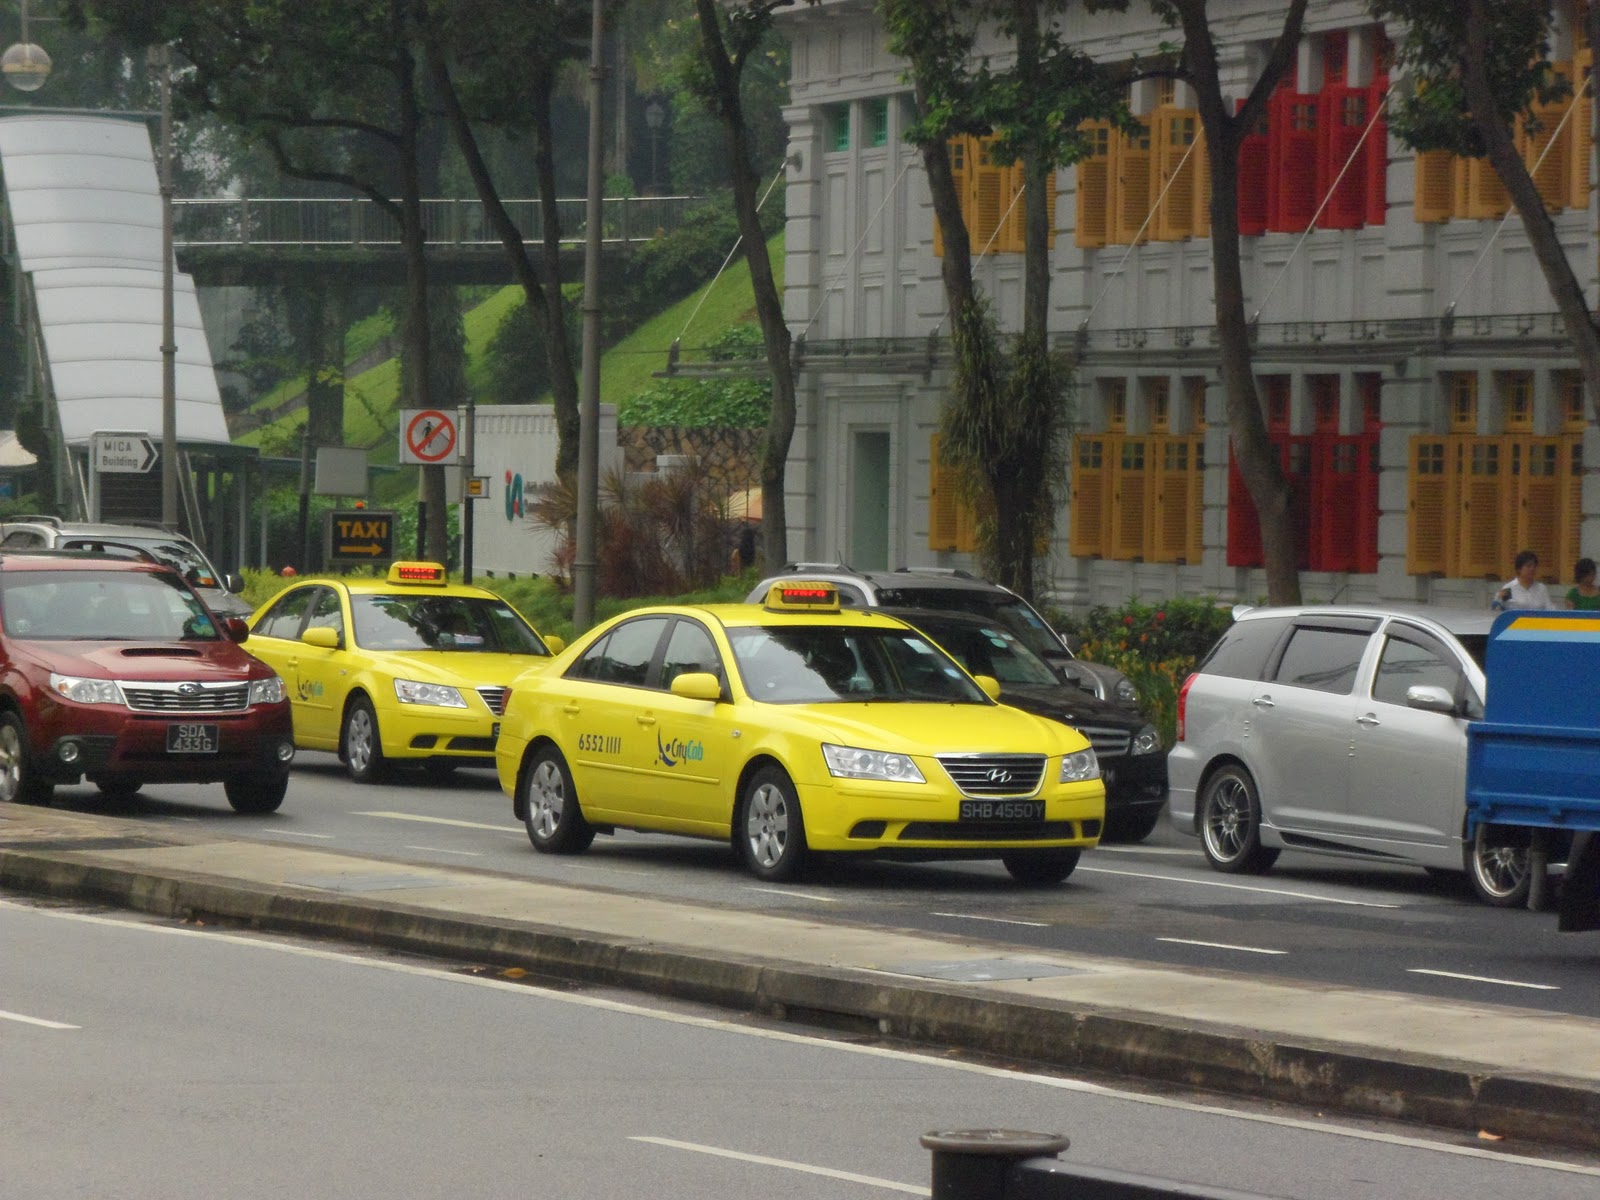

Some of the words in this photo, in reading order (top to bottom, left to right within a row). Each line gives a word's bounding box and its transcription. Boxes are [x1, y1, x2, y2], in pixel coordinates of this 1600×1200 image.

[103, 441, 132, 451] MICA
[102, 455, 138, 469] Building
[337, 520, 387, 539] TAXI
[179, 725, 206, 738] SDA
